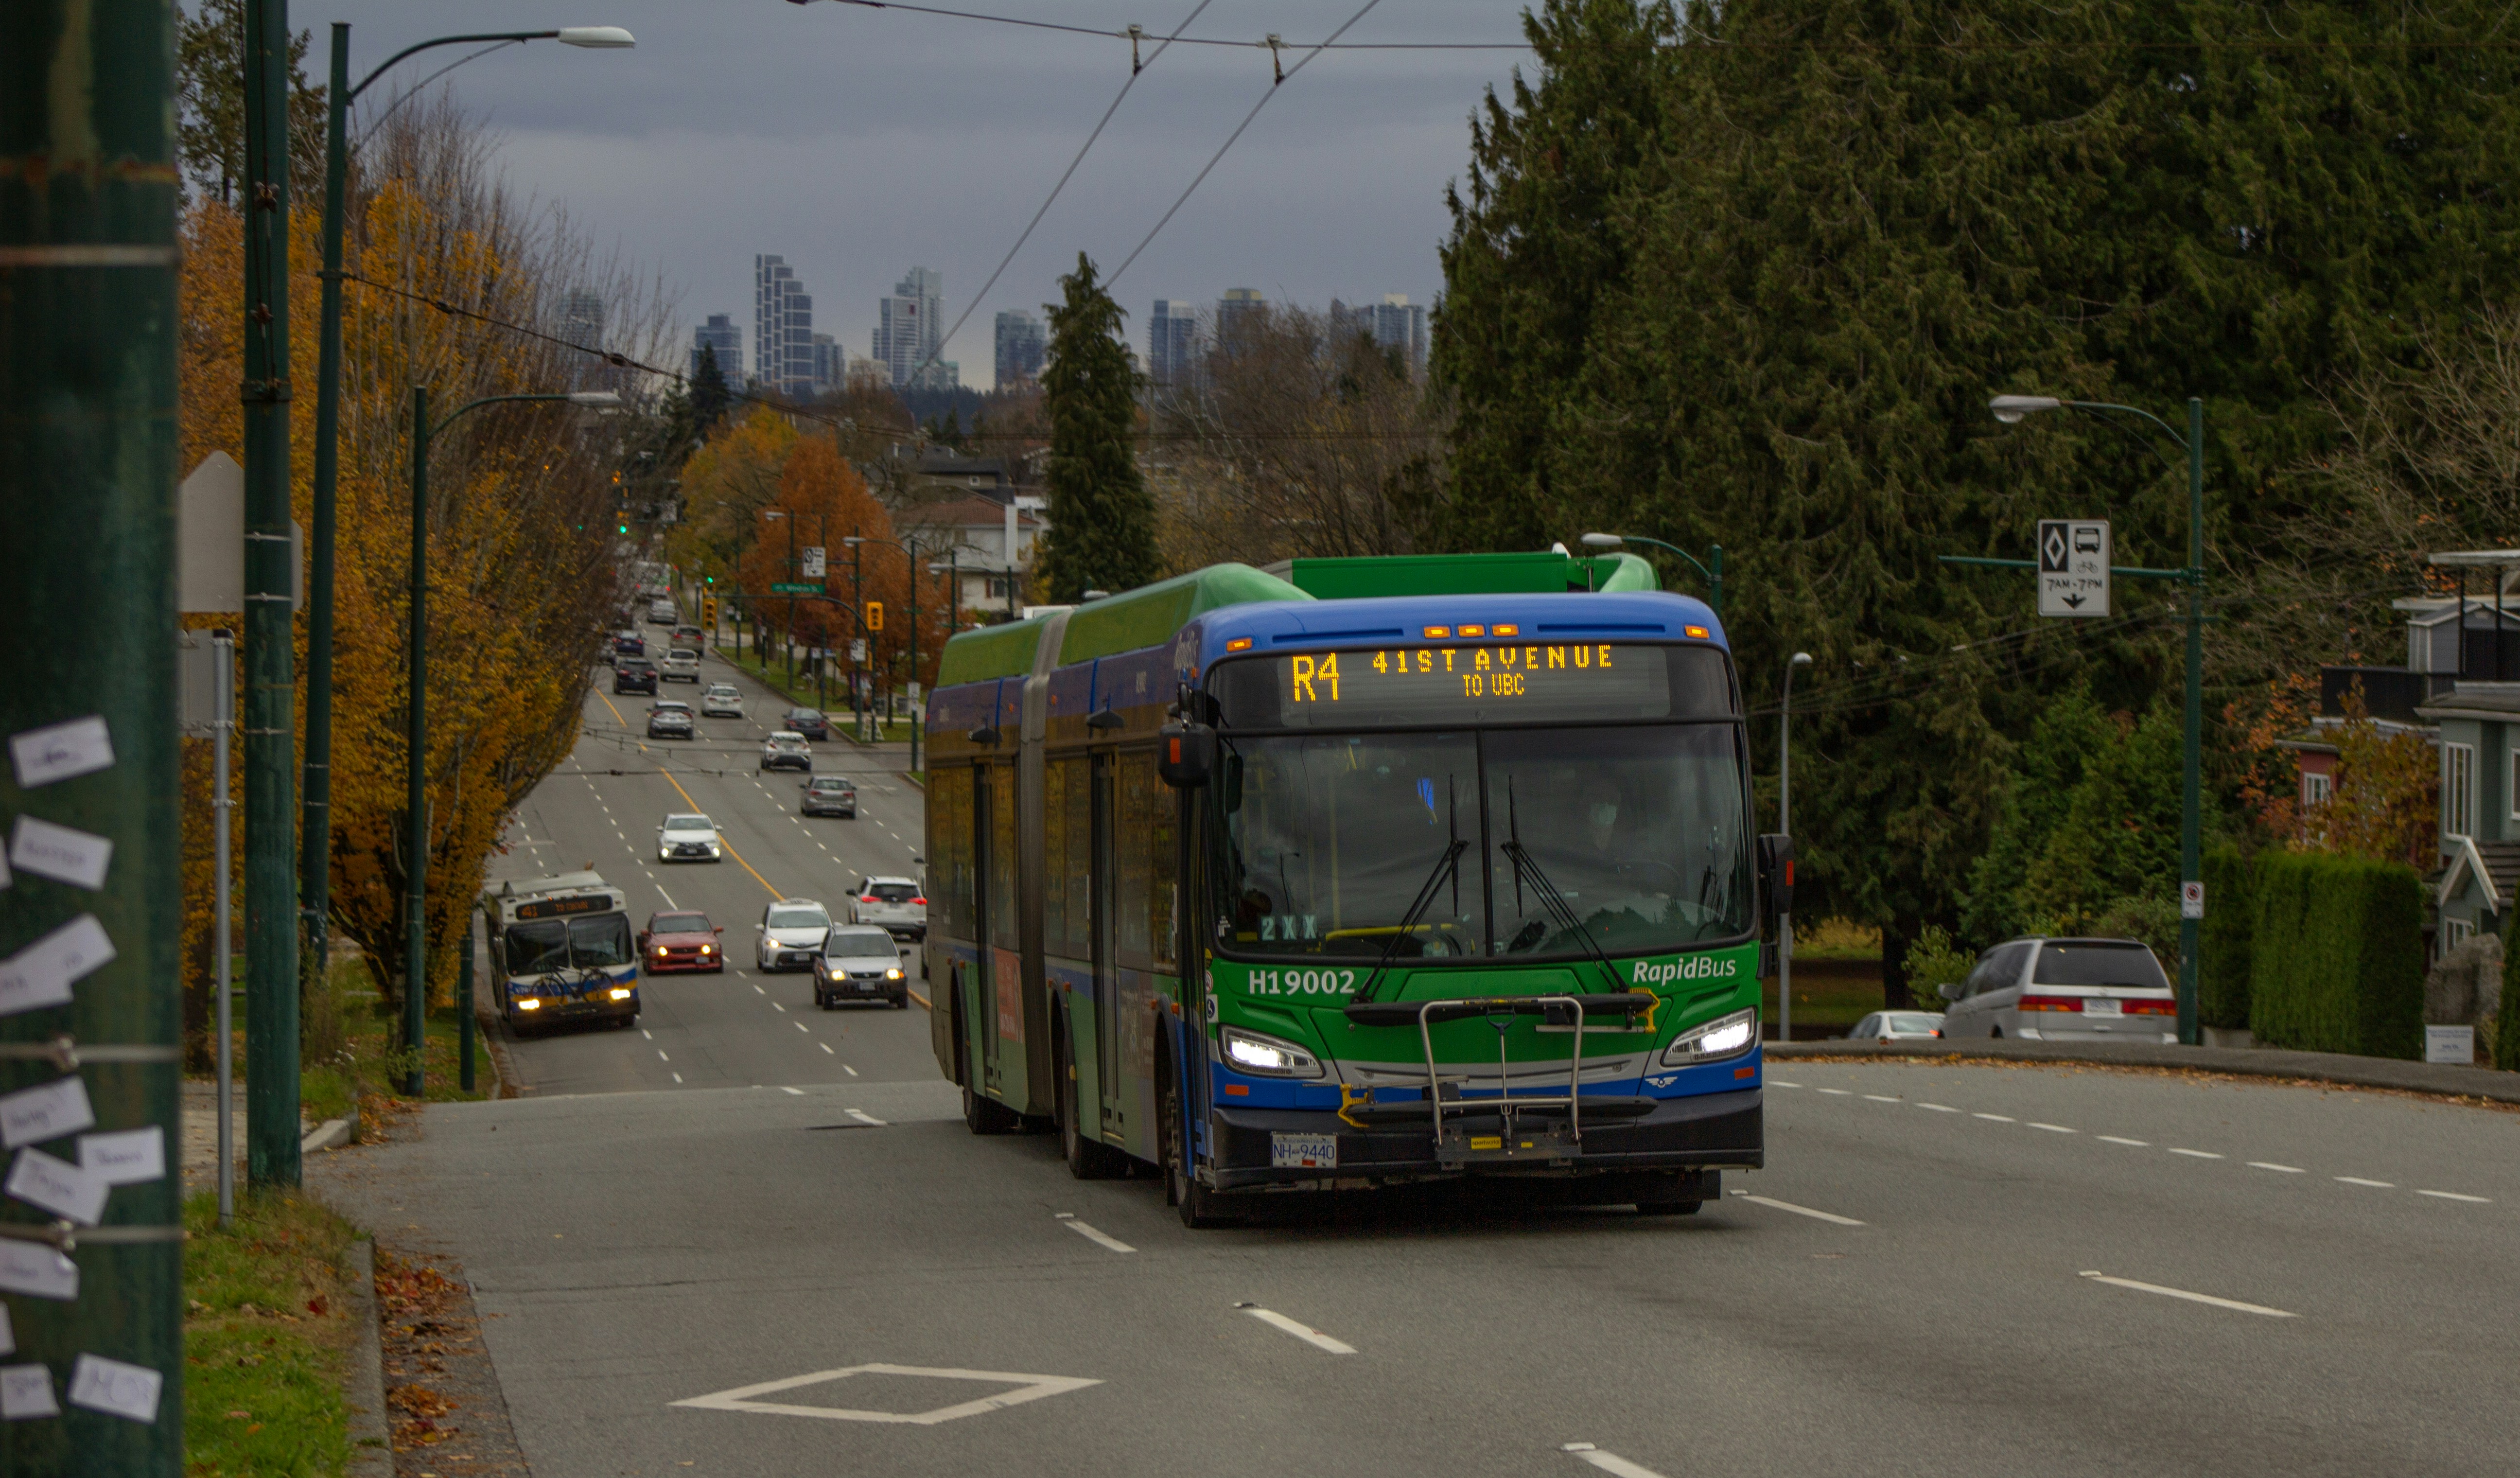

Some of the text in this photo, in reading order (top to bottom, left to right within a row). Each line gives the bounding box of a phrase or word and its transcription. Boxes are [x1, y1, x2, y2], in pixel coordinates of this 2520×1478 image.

[1373, 645, 1612, 674] 41ST AVENUE
[1293, 652, 1339, 701] R4
[1463, 673, 1524, 697] TO UBC
[1249, 970, 1355, 996] H19002
[1632, 956, 1736, 987] RapidBus
[1274, 1144, 1334, 1160] NH 9440
